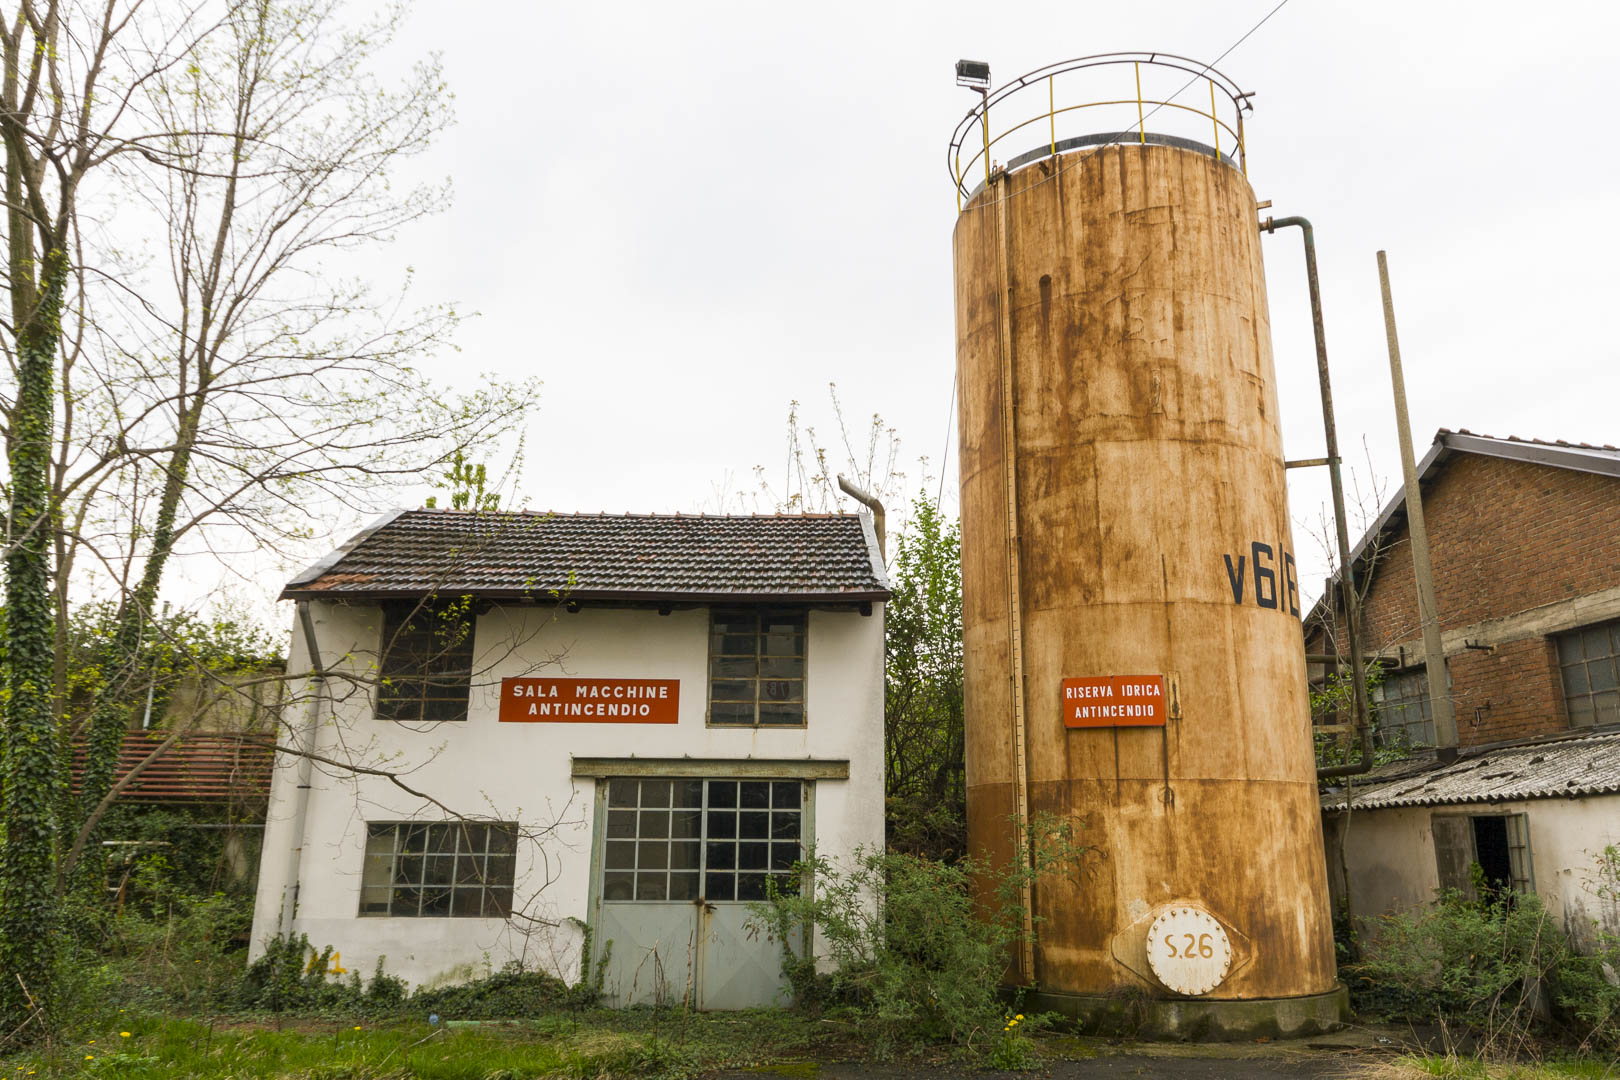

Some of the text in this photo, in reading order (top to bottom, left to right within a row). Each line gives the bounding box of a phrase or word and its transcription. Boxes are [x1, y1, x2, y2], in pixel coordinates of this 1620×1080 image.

[513, 685, 668, 698] SALA MACCHINE
[1066, 684, 1161, 699] RISERVA IDRICA
[528, 703, 650, 716] ANTINCENDIO
[1075, 704, 1154, 718] ANTINCENDIO
[1164, 933, 1213, 959] S.26
